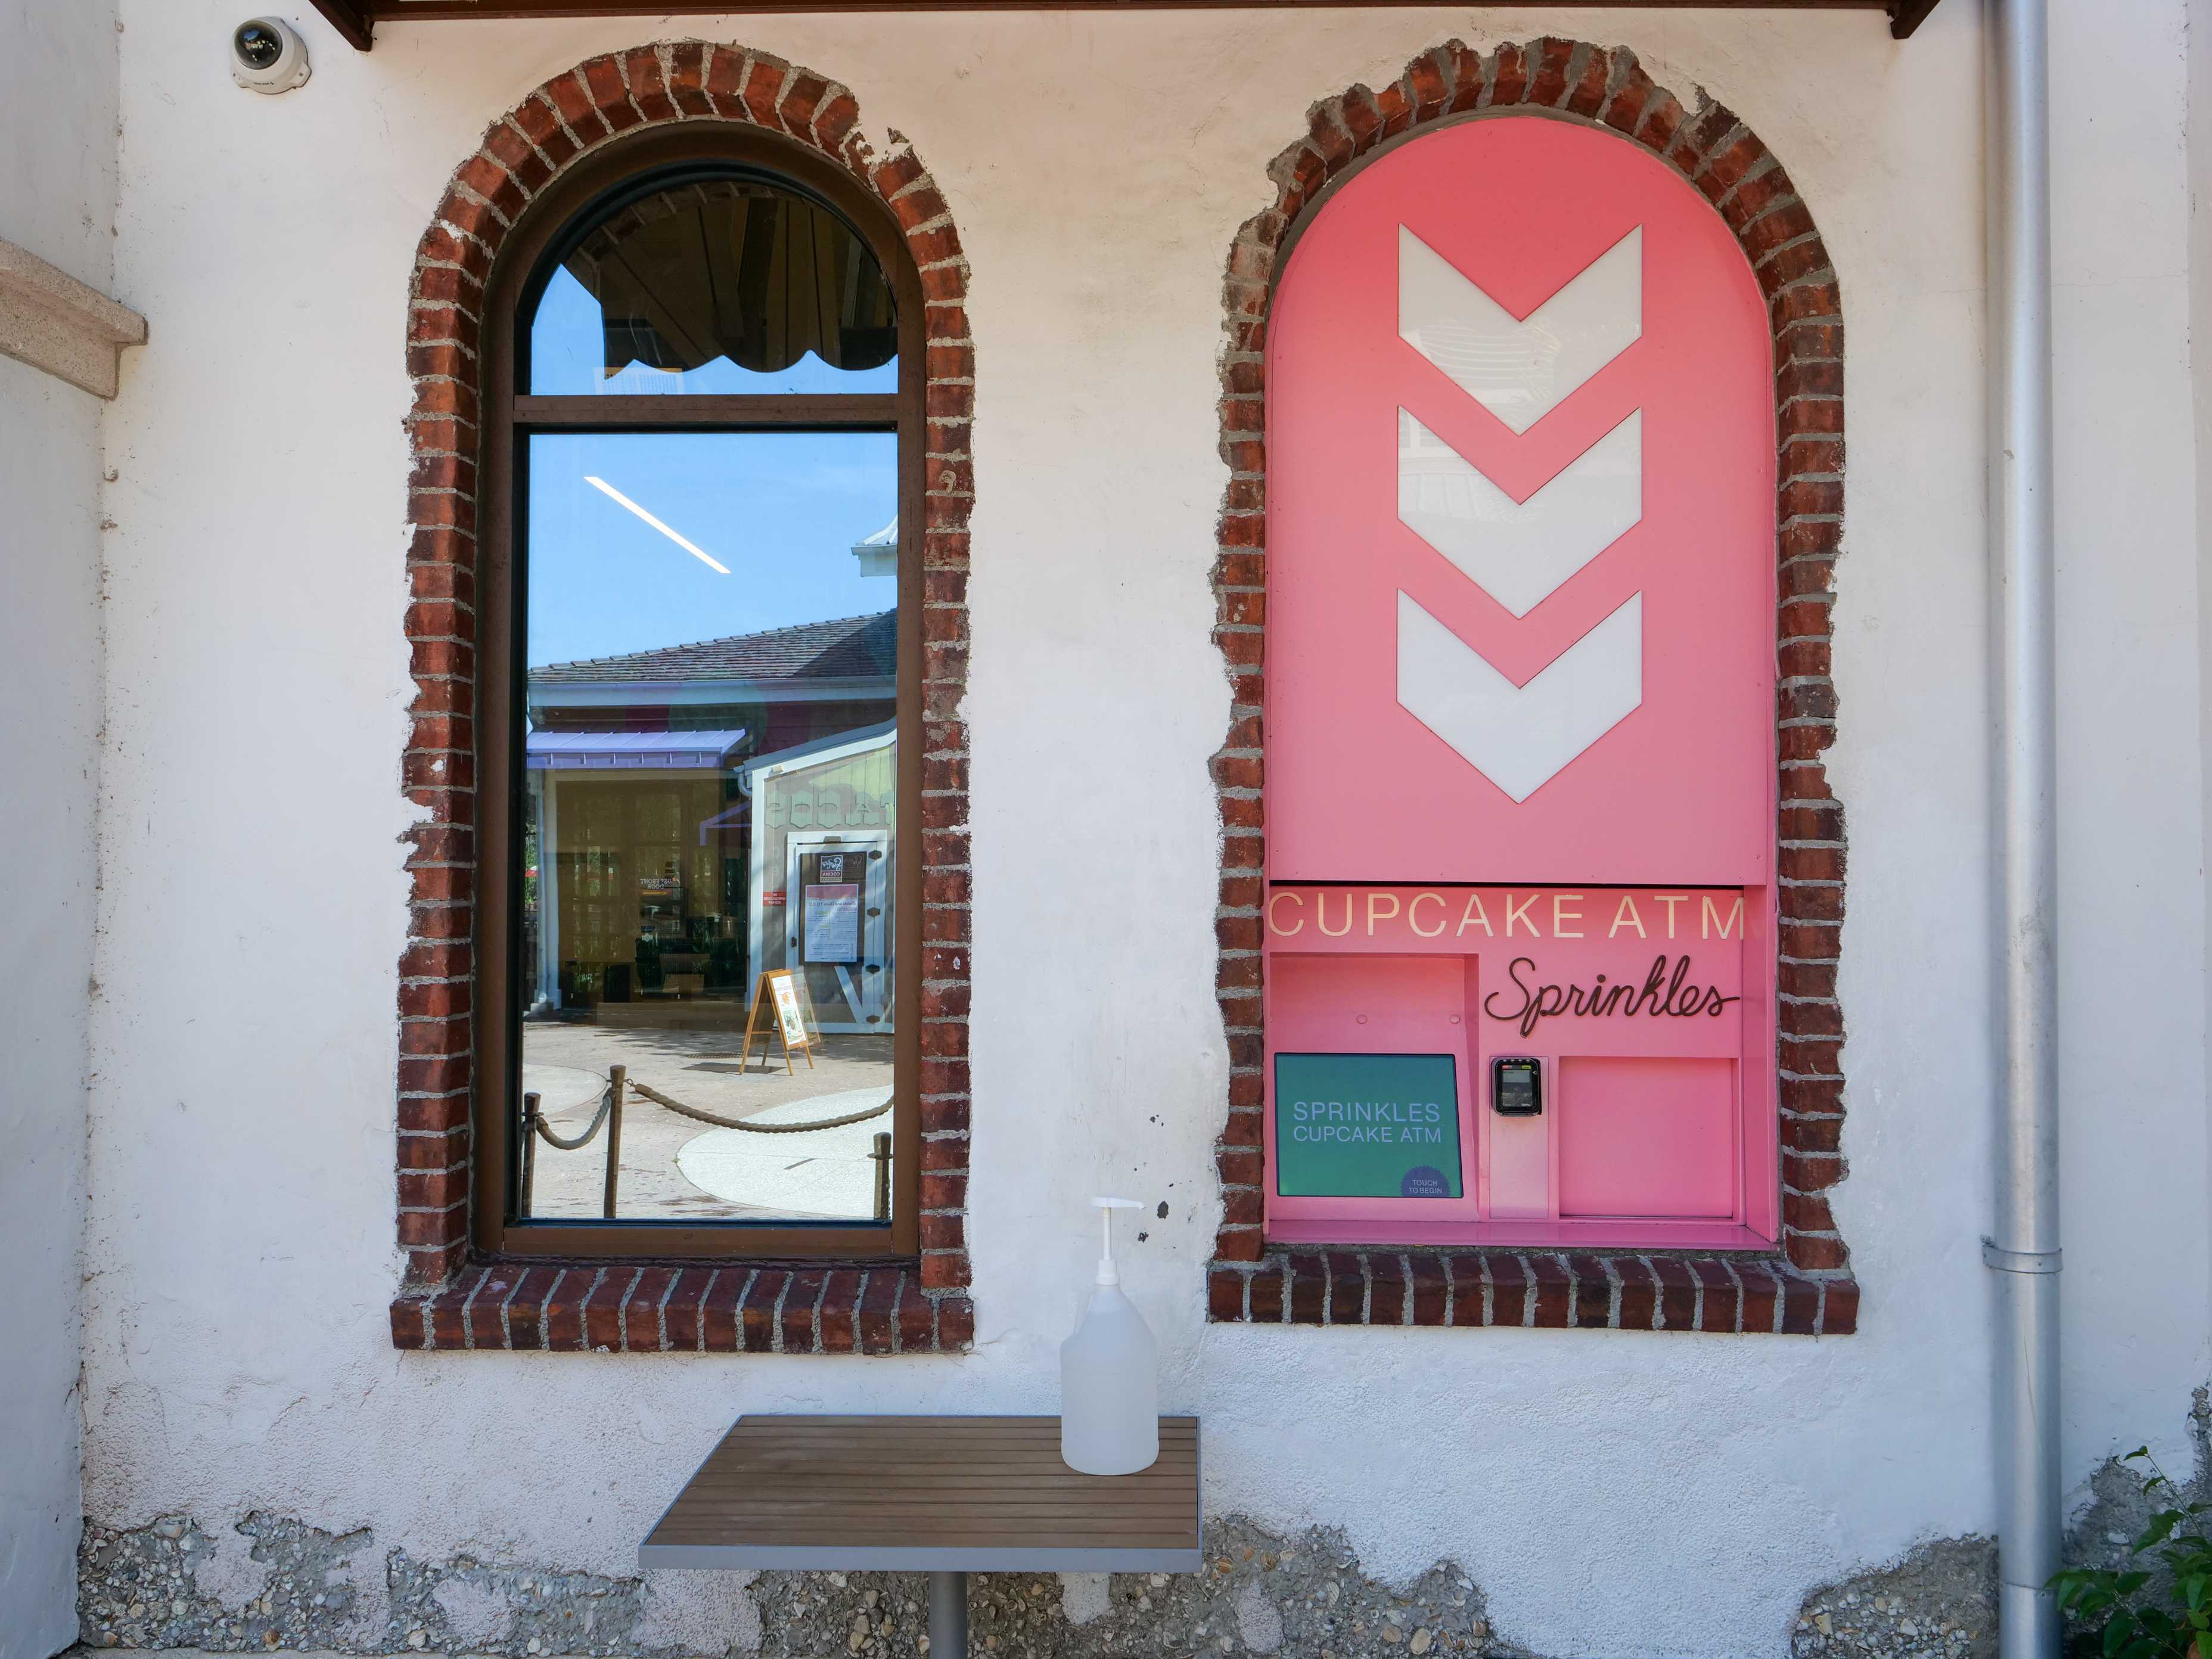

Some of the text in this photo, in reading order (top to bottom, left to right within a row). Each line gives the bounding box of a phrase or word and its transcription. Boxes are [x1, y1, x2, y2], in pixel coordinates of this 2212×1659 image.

[1269, 892, 1744, 940] CUPCAKE ATM
[1484, 955, 1740, 1038] Sprinkles
[1293, 1102, 1440, 1122] SPRINKLES
[1293, 1126, 1441, 1143] CUPCAKE ATM
